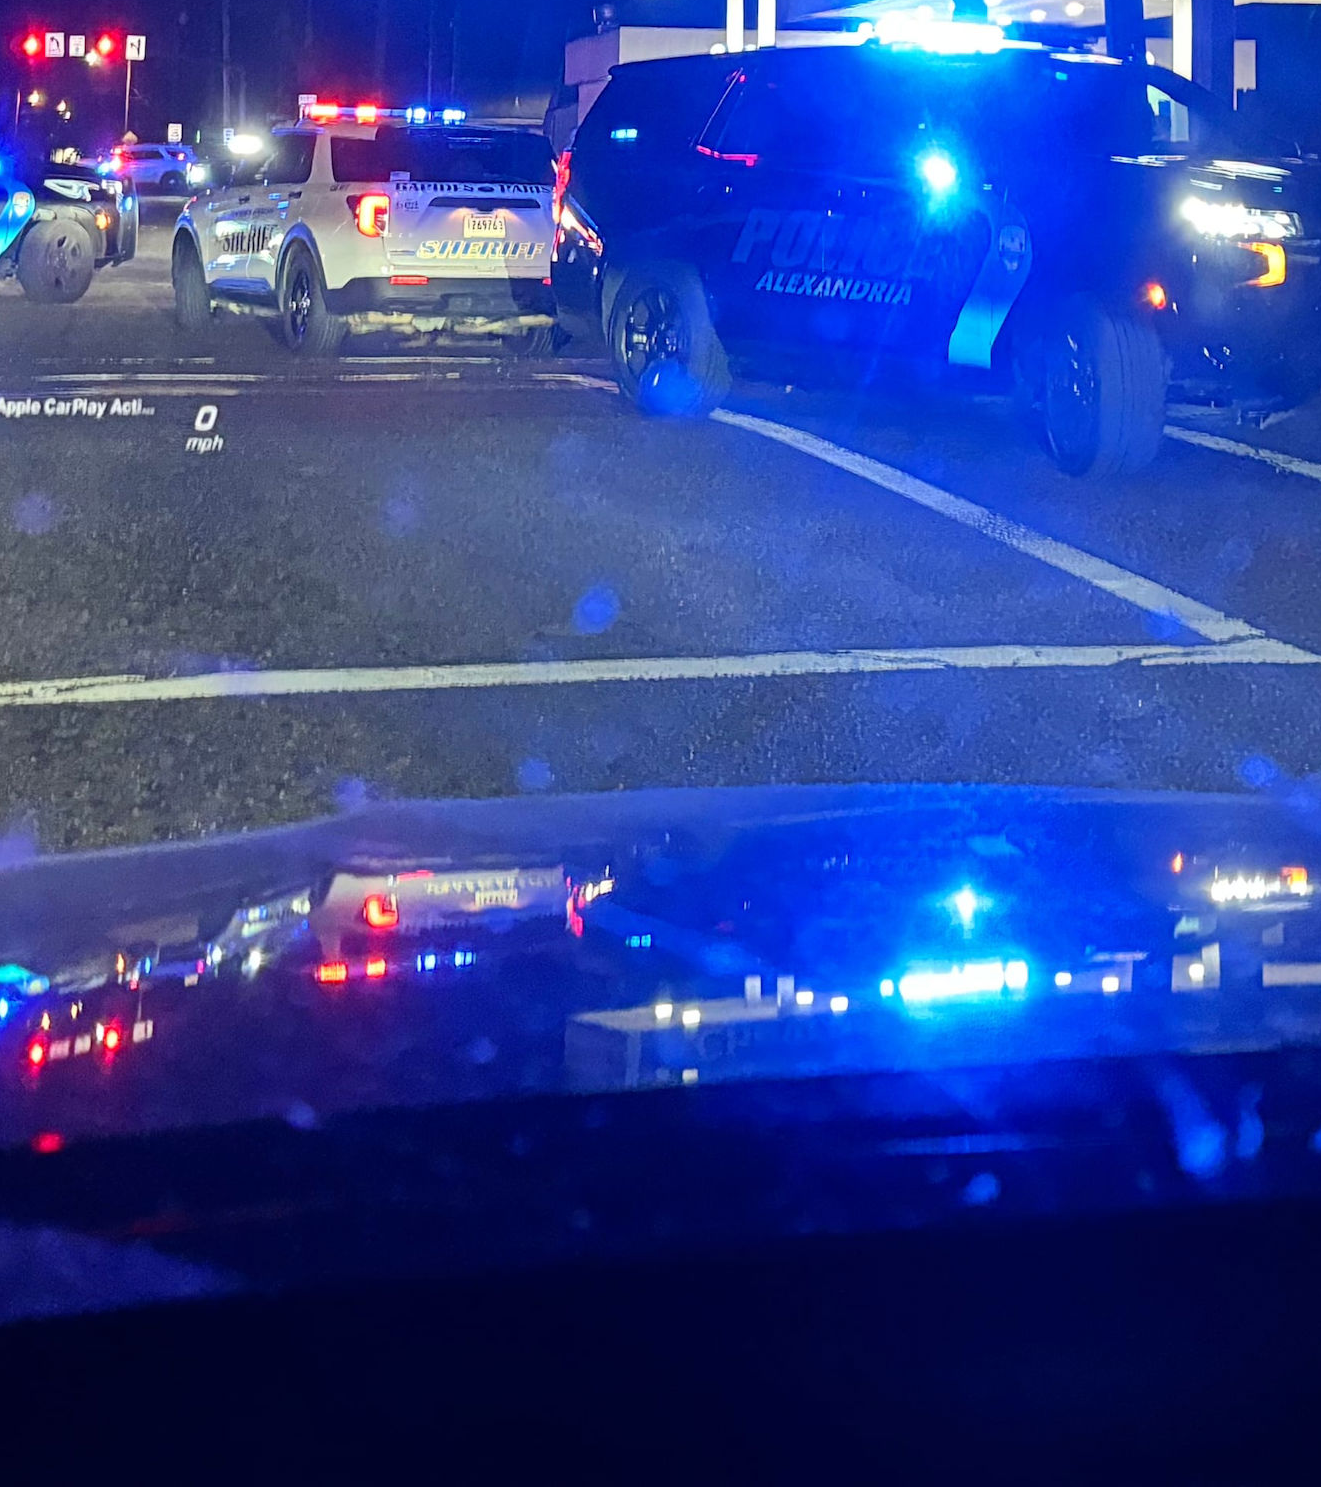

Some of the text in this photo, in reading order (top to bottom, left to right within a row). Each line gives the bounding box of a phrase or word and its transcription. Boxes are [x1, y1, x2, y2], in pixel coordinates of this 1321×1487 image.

[500, 184, 551, 194] PARIS
[416, 240, 546, 260] SHERIFF
[730, 207, 937, 281] POLICE
[754, 270, 914, 305] ALEXANDRIA
[44, 397, 107, 419] CarPlay
[194, 405, 218, 432] 0
[185, 434, 224, 455] mph
